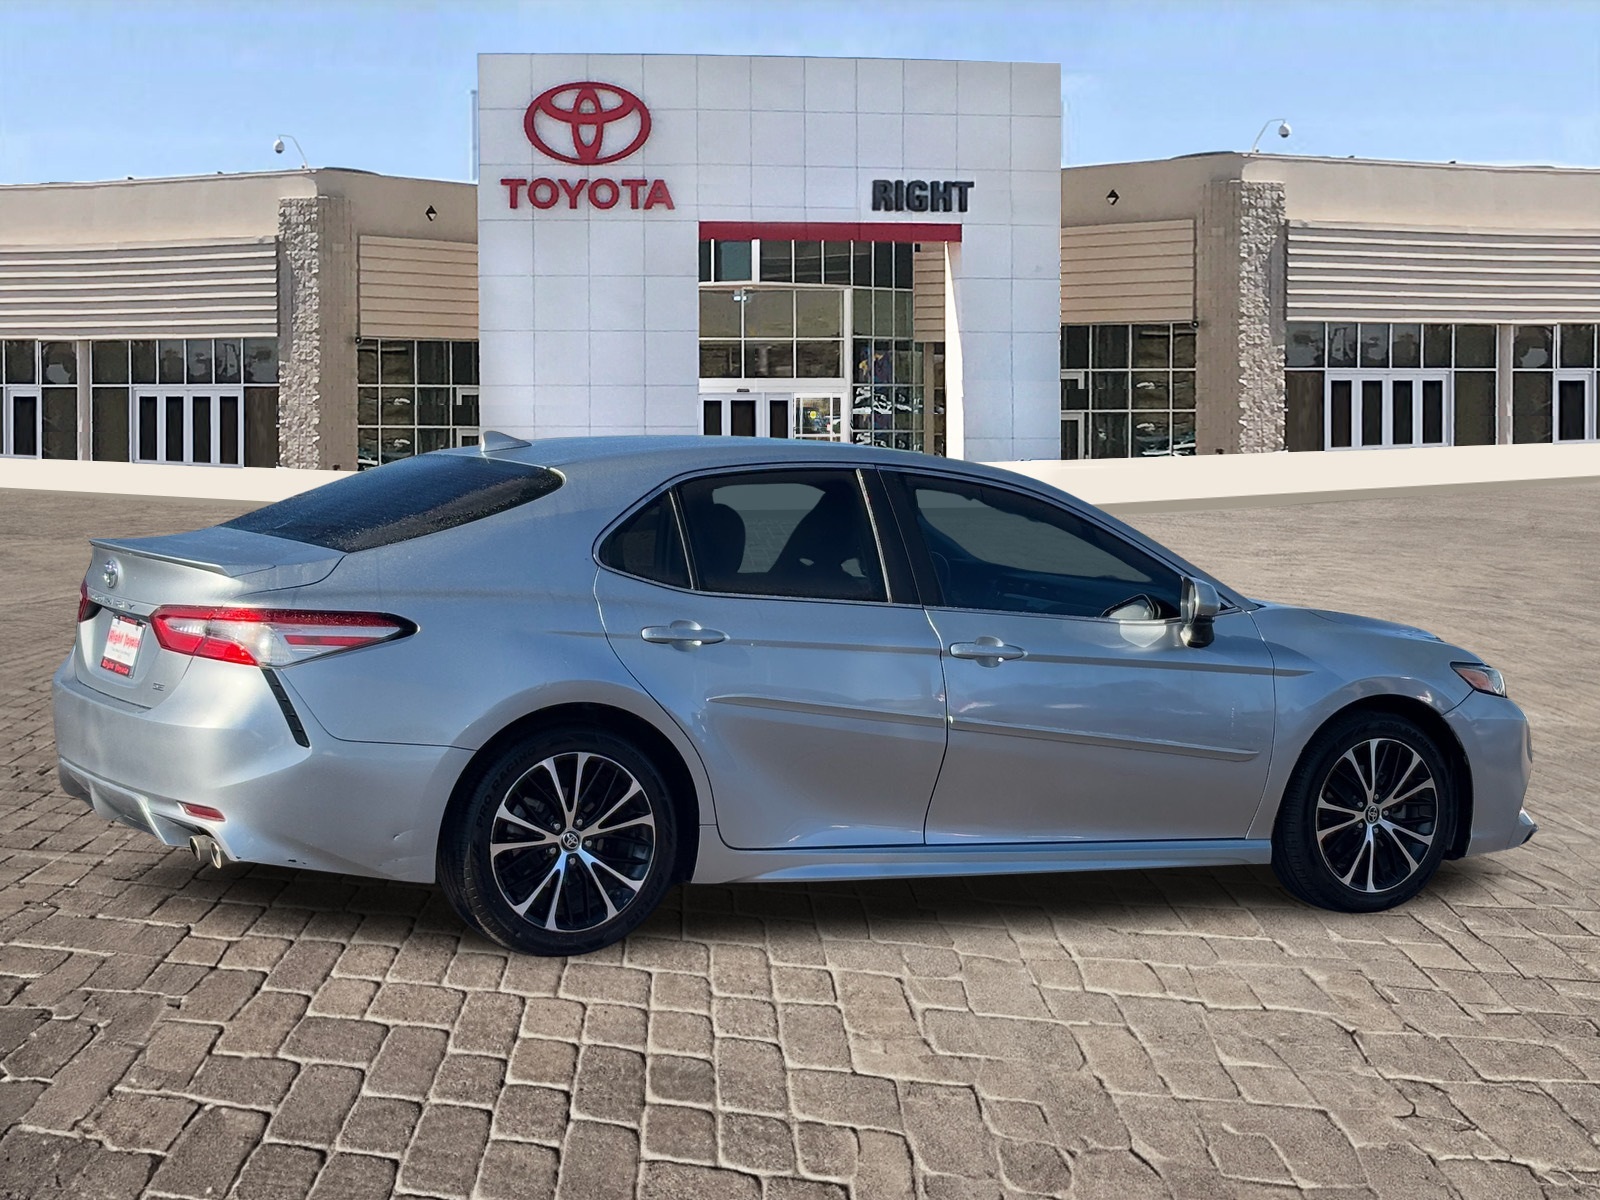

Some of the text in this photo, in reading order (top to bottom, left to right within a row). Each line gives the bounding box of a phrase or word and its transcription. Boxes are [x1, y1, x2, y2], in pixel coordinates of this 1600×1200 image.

[500, 177, 675, 210] TOYOTA
[871, 179, 975, 212] RIGHT
[476, 793, 492, 828] PRO
